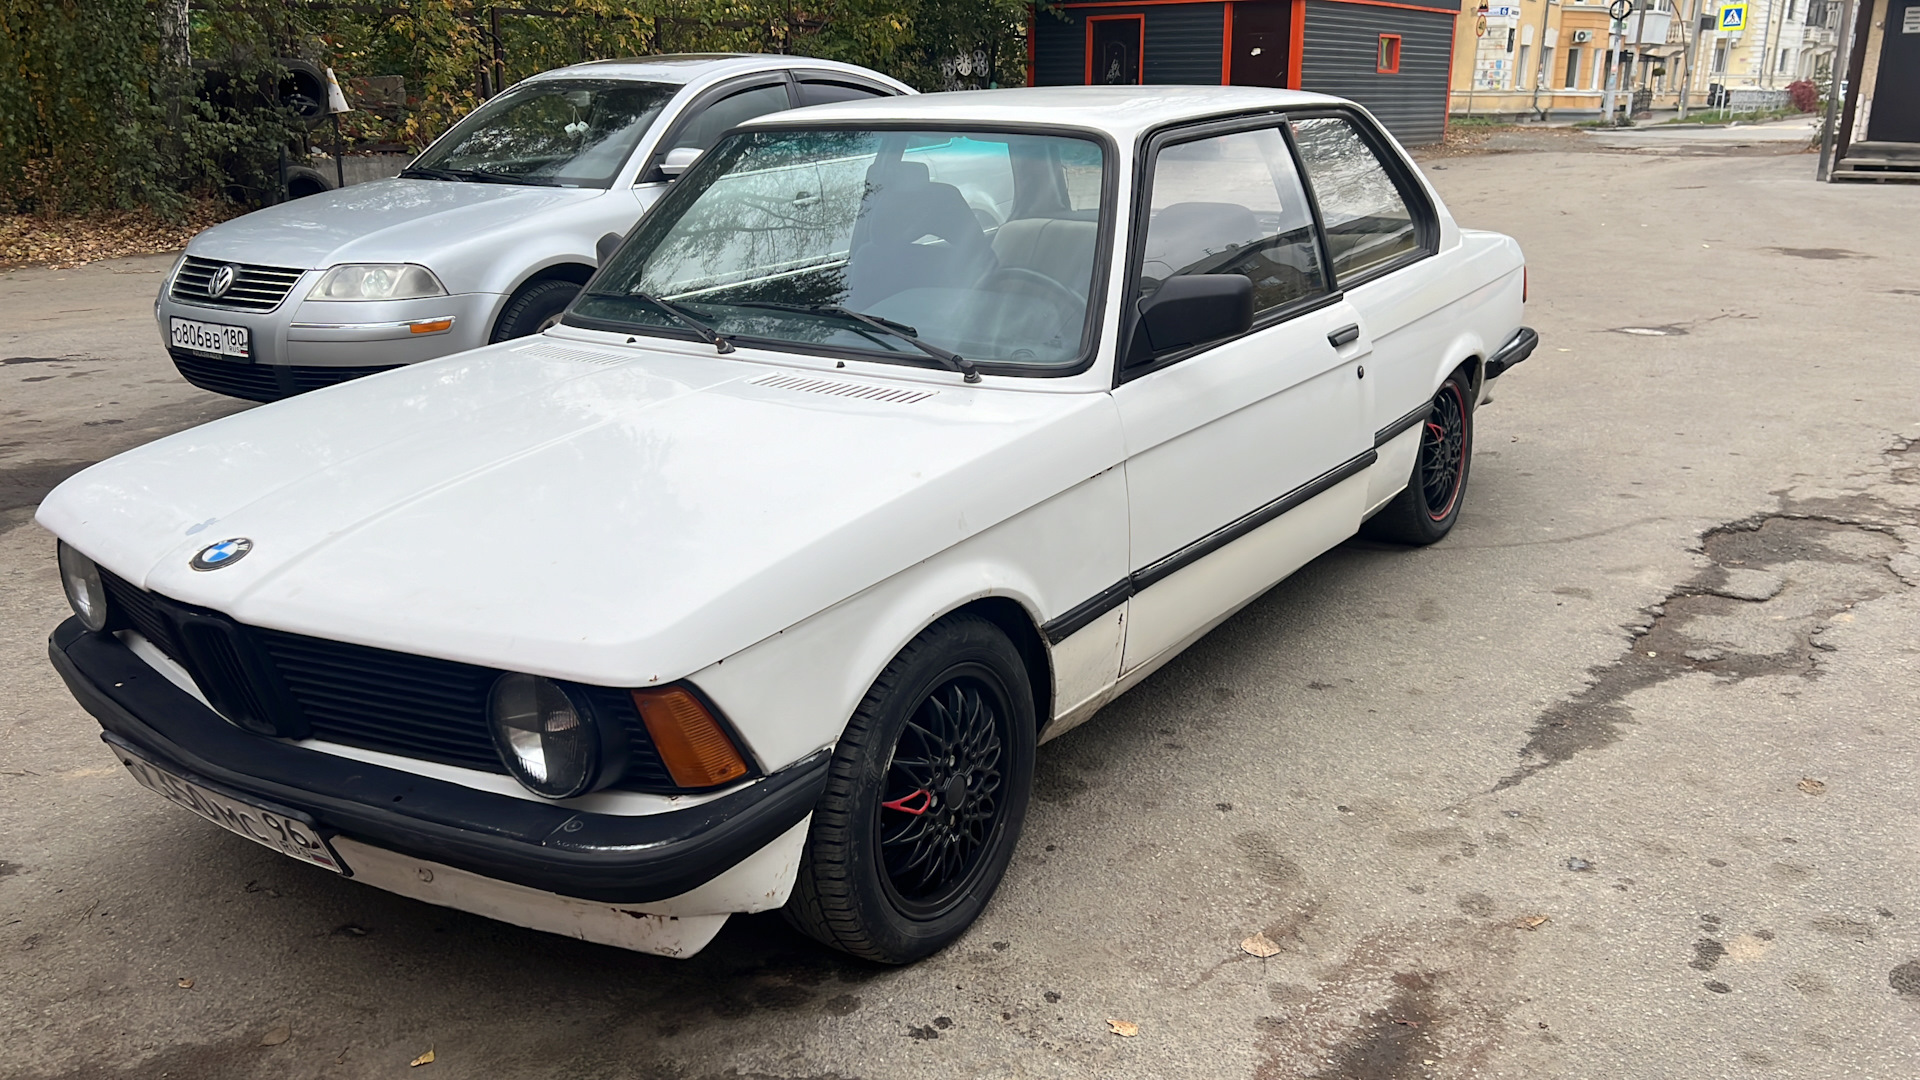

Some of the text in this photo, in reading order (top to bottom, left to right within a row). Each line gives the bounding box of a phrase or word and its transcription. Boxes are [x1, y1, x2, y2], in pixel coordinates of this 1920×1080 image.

[223, 328, 244, 347] 180
[229, 345, 240, 354] RUS
[261, 812, 311, 849] 96
[279, 839, 311, 859] RUS
